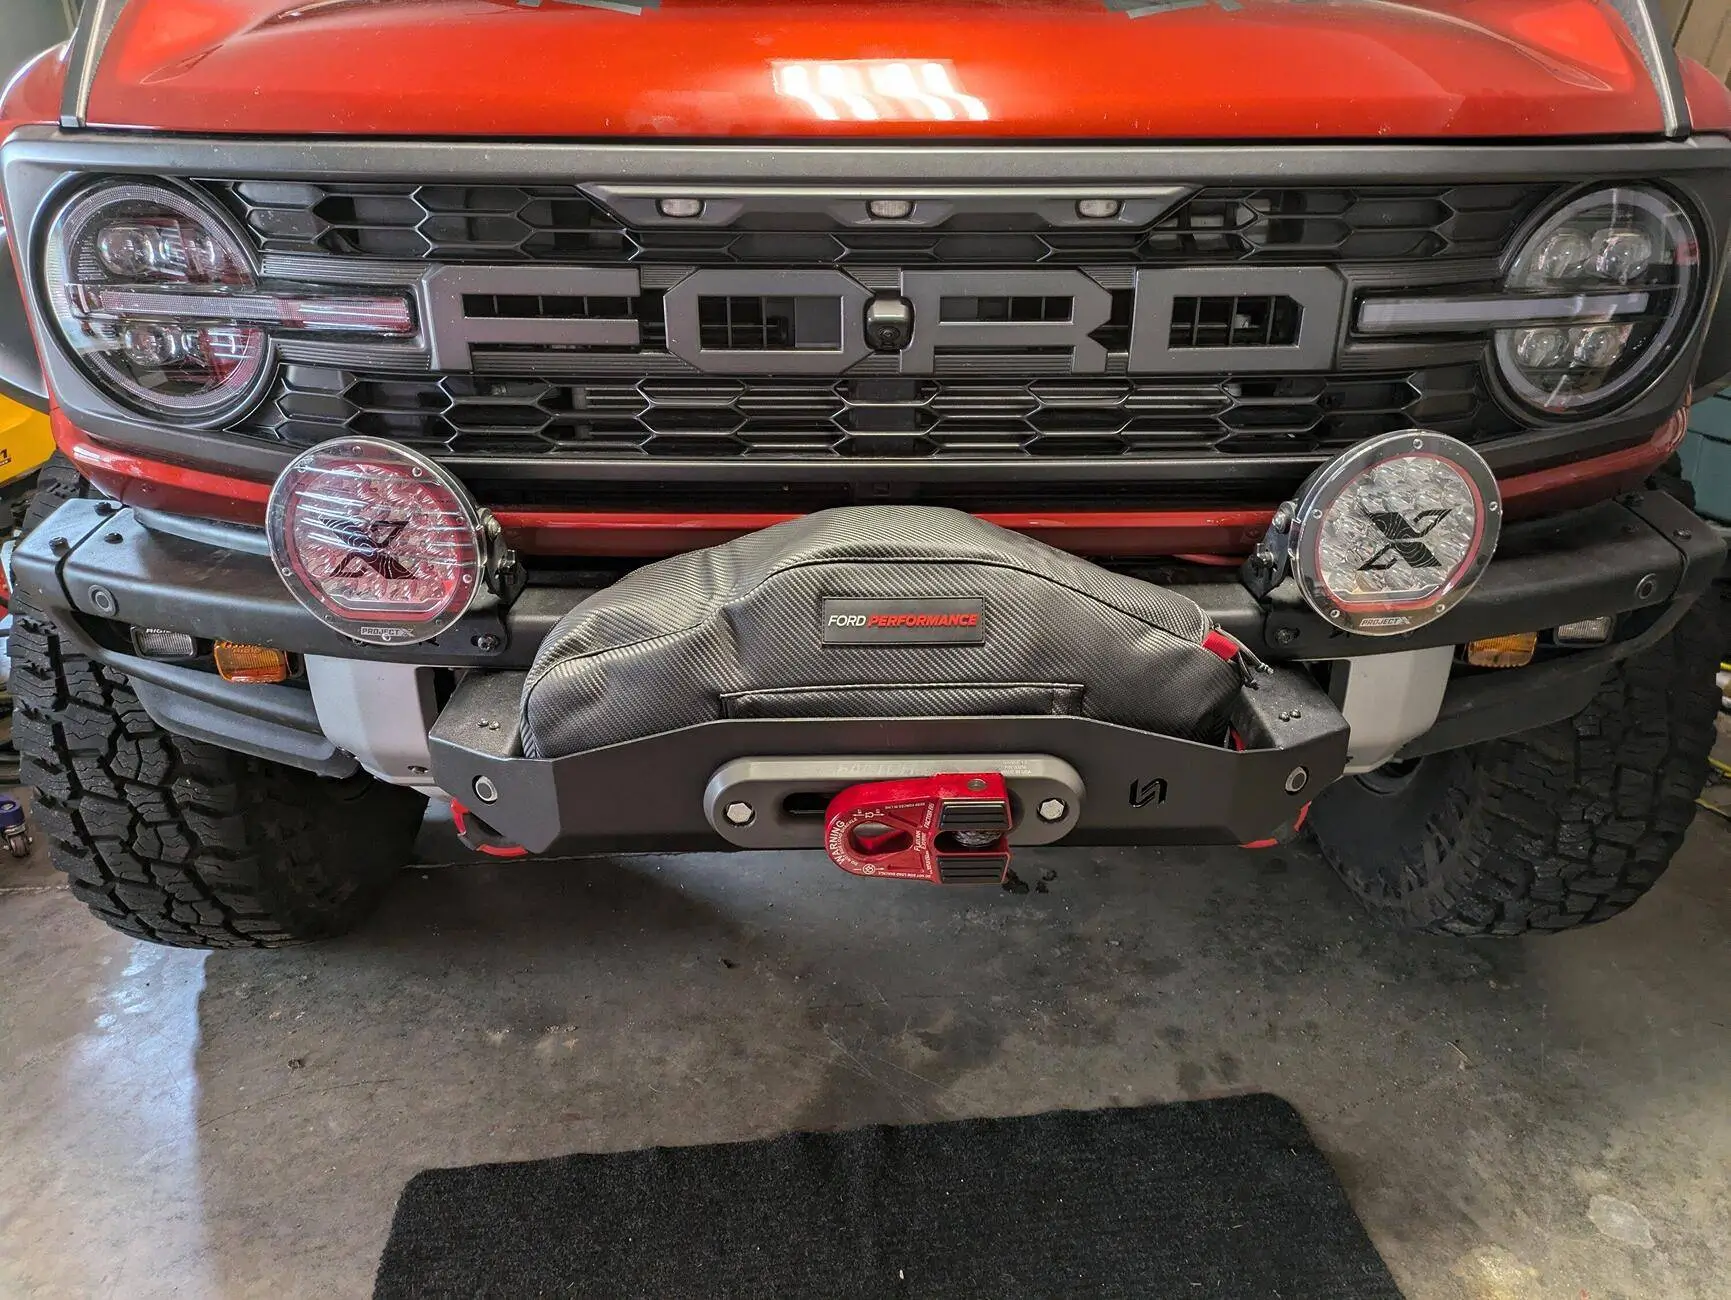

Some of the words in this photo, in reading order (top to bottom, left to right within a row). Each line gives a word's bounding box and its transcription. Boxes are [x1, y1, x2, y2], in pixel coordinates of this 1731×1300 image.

[424, 265, 1347, 374] FORD
[828, 615, 866, 627] FORD
[868, 613, 979, 627] PERFORMANCE
[829, 820, 845, 865] WARNING
